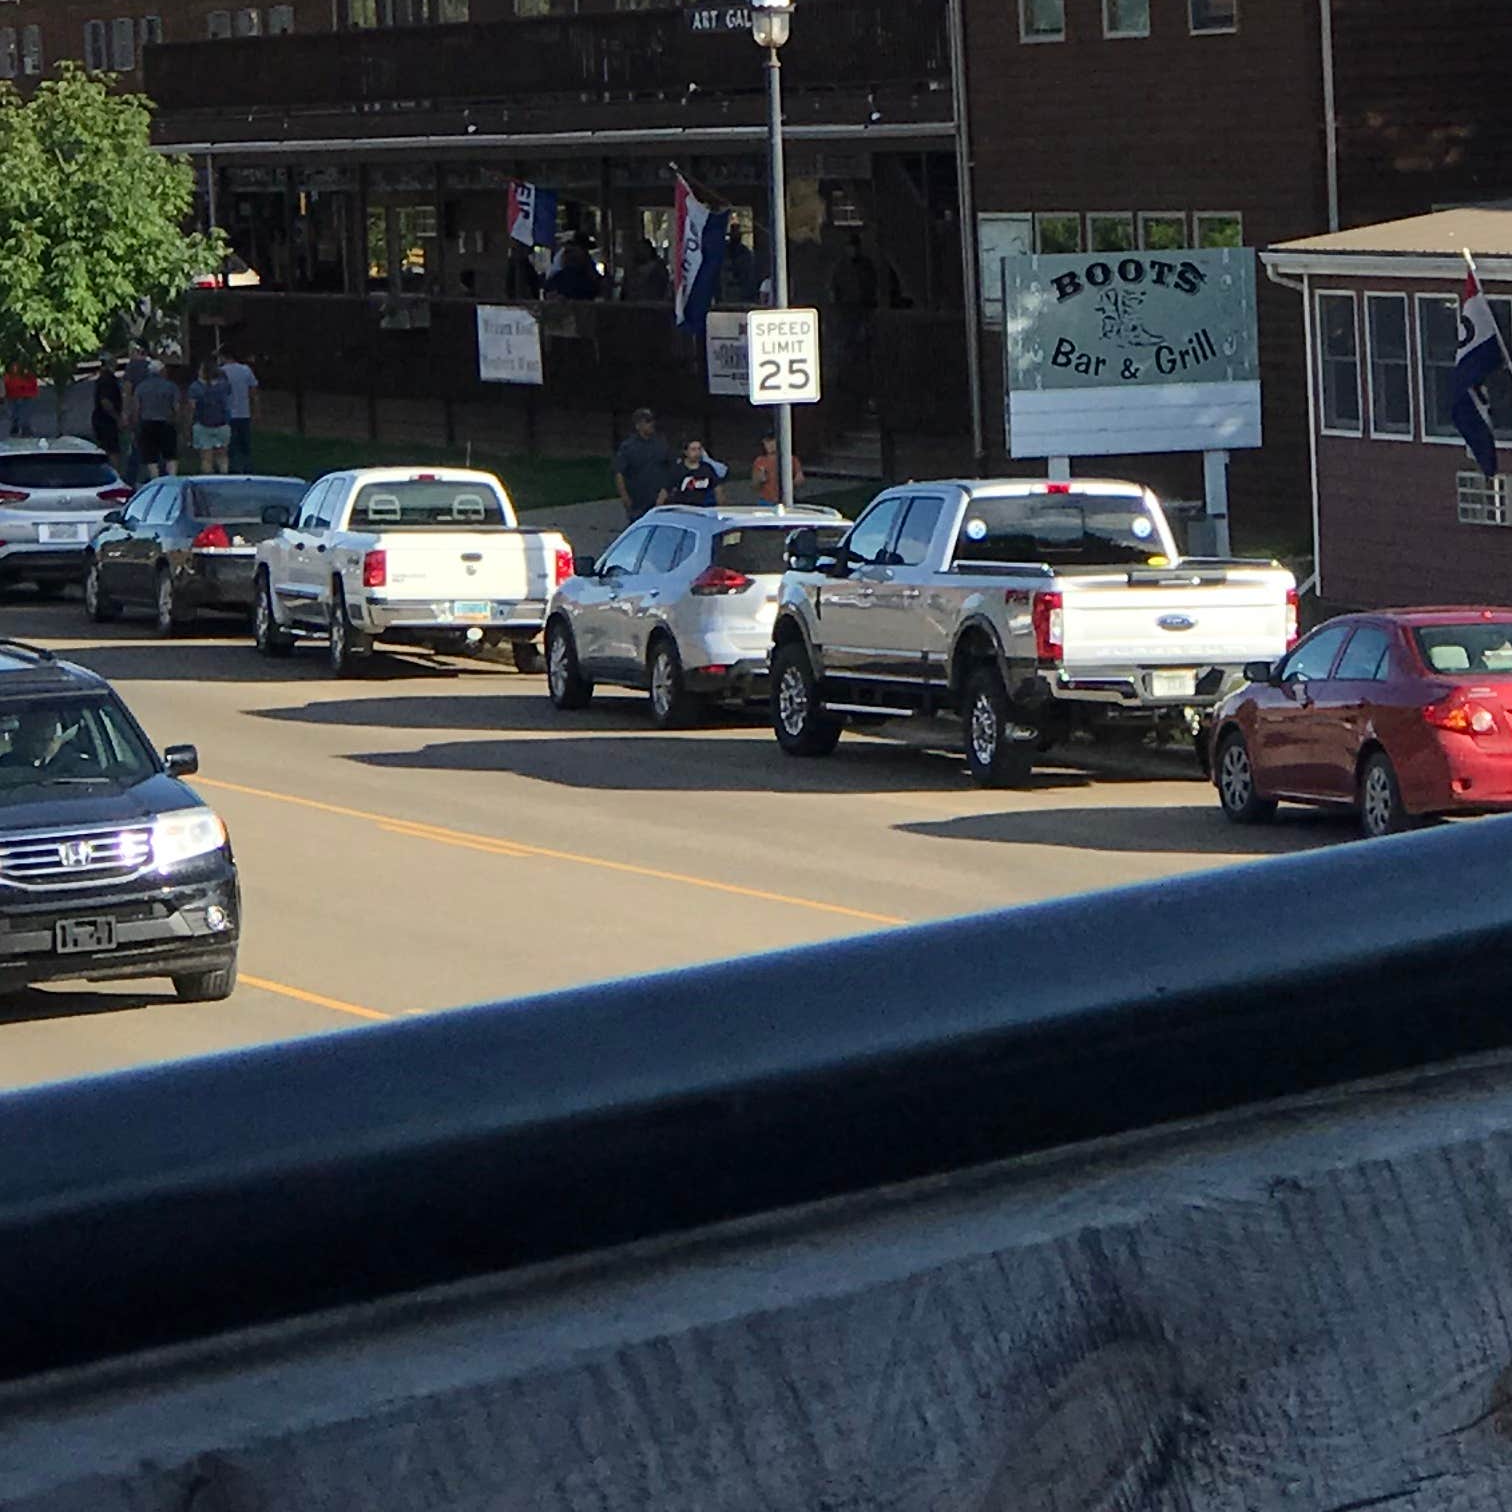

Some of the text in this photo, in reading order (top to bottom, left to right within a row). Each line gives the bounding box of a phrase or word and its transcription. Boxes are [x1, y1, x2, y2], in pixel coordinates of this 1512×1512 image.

[692, 9, 753, 29] ART GAL
[1051, 259, 1206, 303] BOOTS
[756, 321, 811, 336] SPEED
[762, 340, 804, 355] LIMIT
[1051, 329, 1216, 379] Bar & Grill
[759, 358, 810, 391] 25
